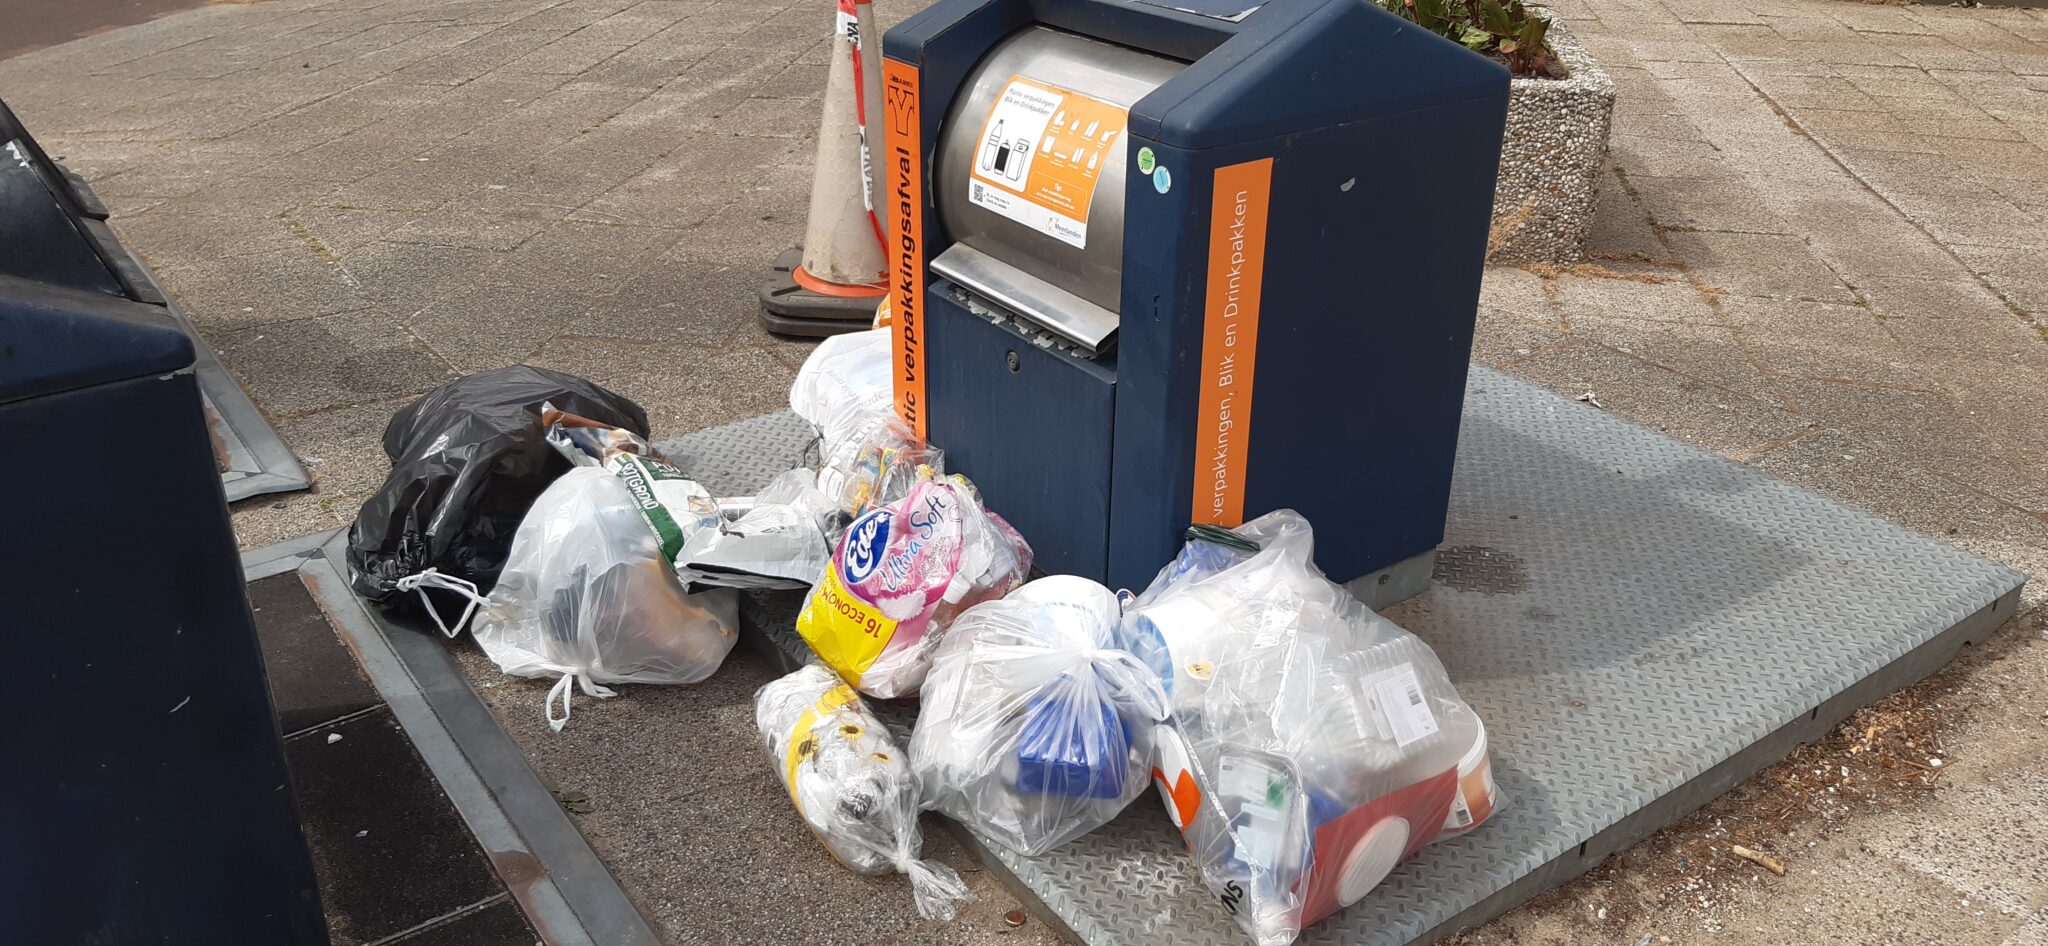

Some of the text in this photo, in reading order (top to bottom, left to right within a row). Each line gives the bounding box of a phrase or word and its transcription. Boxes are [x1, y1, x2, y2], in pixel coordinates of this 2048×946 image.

[896, 147, 918, 382] verpakkingsafval
[1055, 223, 1082, 239] Meerlanden
[1212, 189, 1248, 518] verpakkingen, Blik en Drinkpakken
[880, 540, 923, 591] Ultra
[910, 494, 947, 540] Soft
[864, 618, 882, 639] 16
